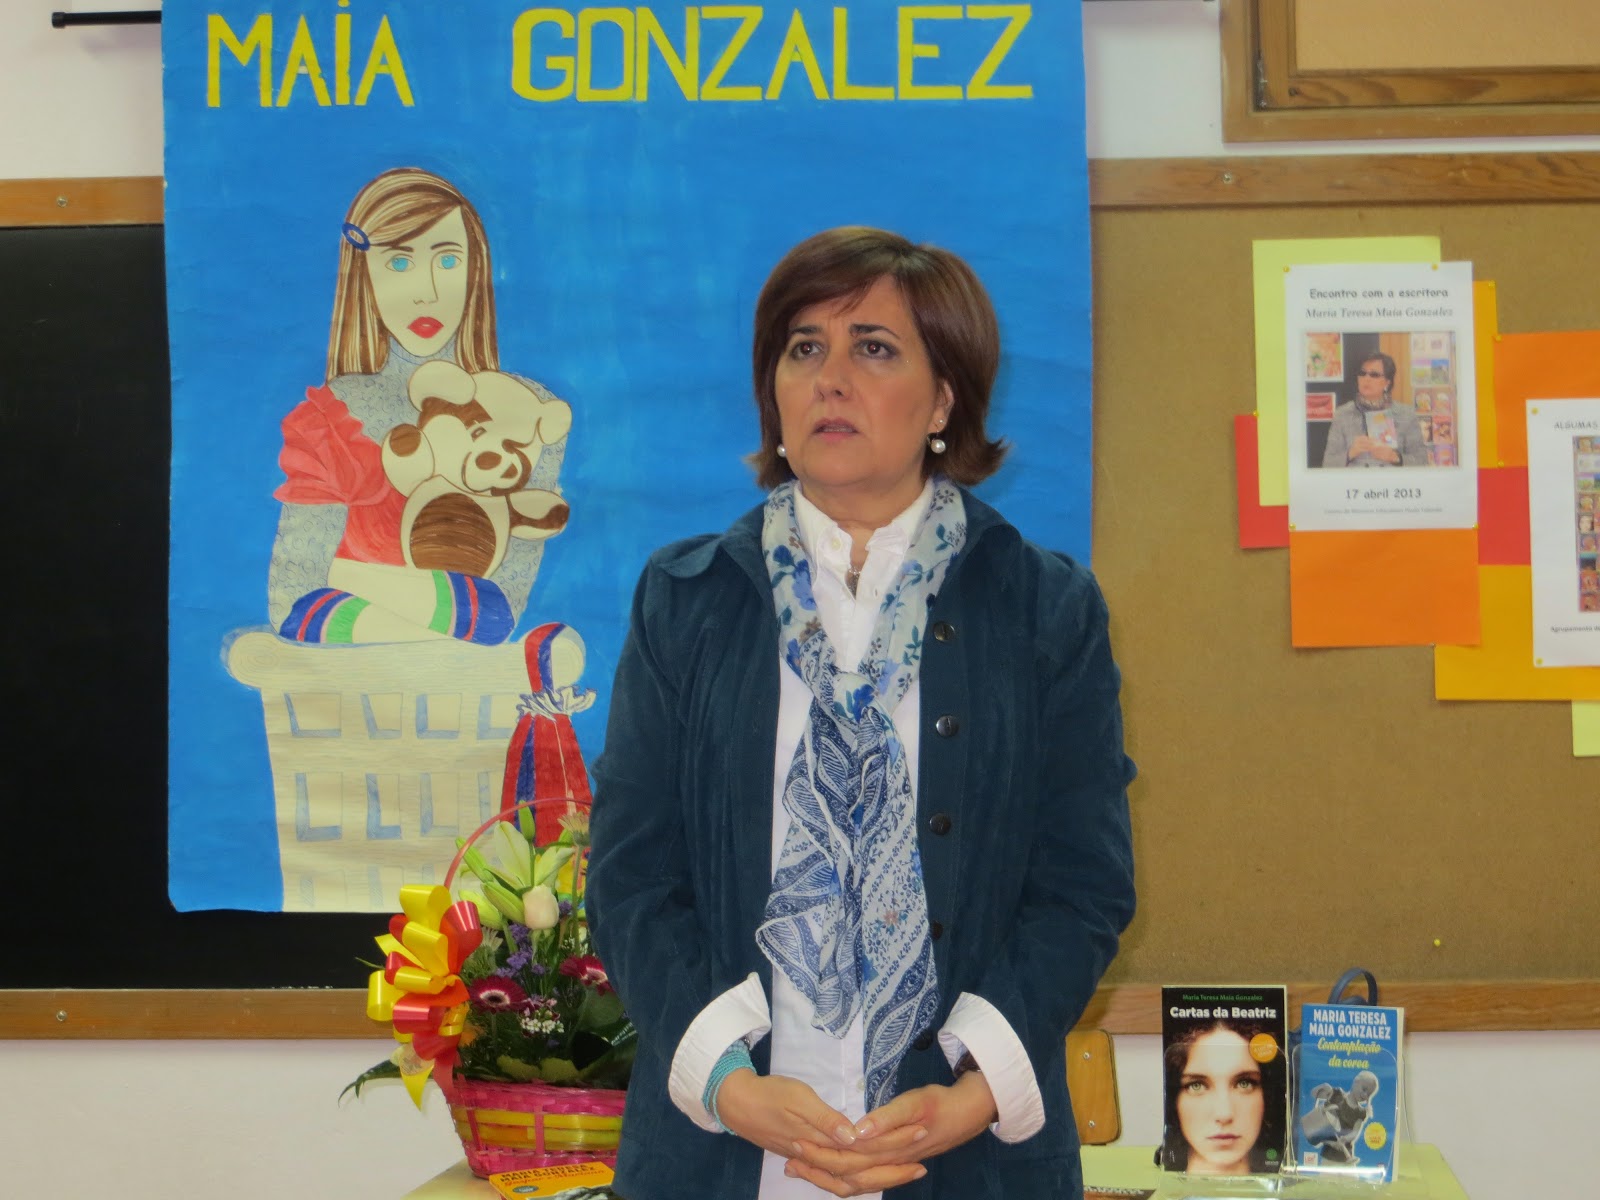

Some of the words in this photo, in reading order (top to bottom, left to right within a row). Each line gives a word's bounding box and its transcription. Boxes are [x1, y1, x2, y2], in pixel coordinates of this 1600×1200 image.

[512, 5, 1033, 102] GONZALEZ
[1309, 288, 1357, 299] Encontro
[1362, 289, 1383, 298] com
[1387, 289, 1394, 298] a
[1399, 287, 1449, 298] escritora
[1306, 307, 1337, 318] Maria
[1341, 307, 1372, 318] Teresa
[1345, 488, 1359, 499] 17
[1364, 488, 1389, 499] abril
[1394, 487, 1422, 499] 2013
[1170, 1006, 1210, 1018] Cartas
[1213, 1006, 1228, 1018] da
[1231, 1006, 1277, 1019] Beatriz
[1313, 1008, 1346, 1024] MARIA
[1348, 1010, 1387, 1026] TERESA
[1309, 1022, 1335, 1037] MAIA
[1337, 1024, 1391, 1040] GONZALEZ
[1317, 1037, 1382, 1056] Contemplação
[1328, 1054, 1341, 1067] da
[1343, 1058, 1370, 1069] coroa
